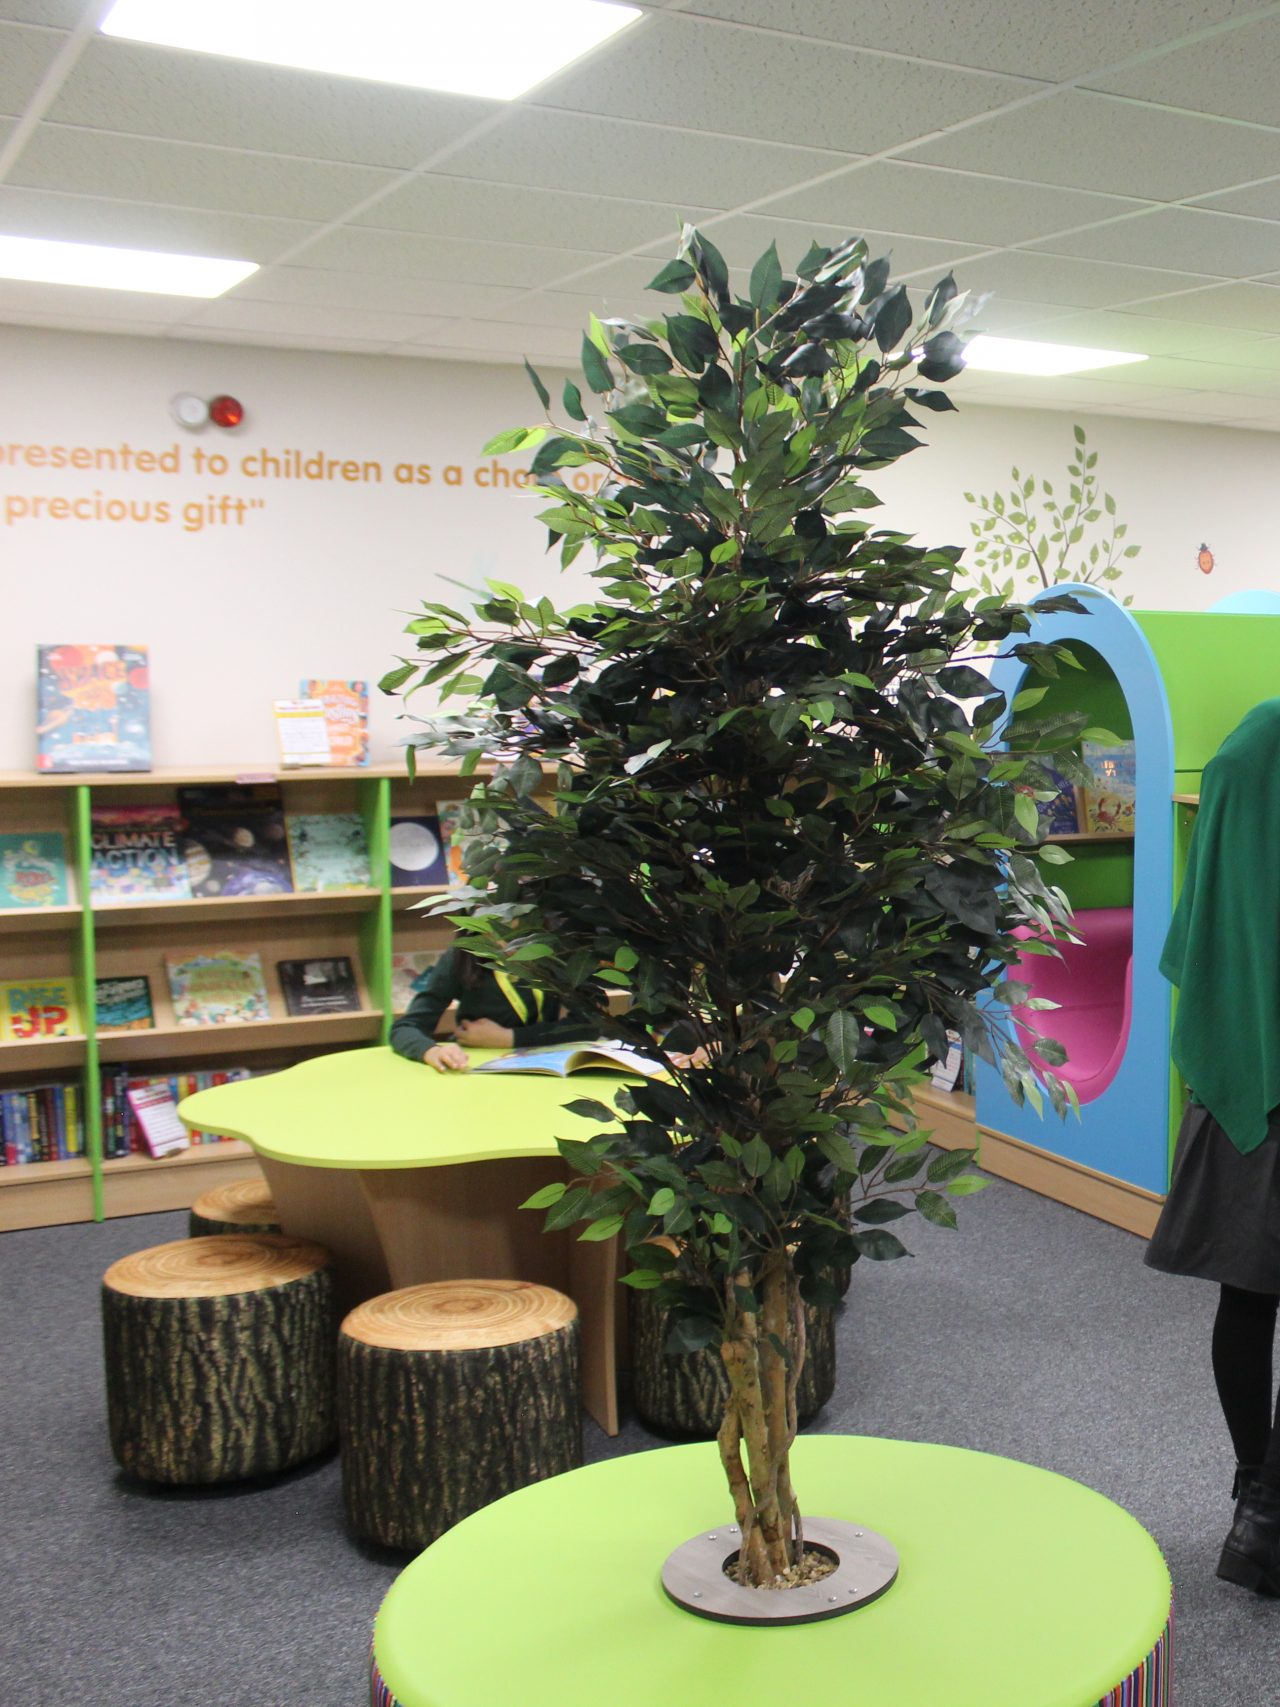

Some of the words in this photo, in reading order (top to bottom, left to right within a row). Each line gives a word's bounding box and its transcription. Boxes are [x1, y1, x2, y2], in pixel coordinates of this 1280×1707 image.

[0, 443, 181, 473] resented
[192, 446, 229, 476] to
[241, 448, 383, 482] children
[394, 463, 431, 485] as
[442, 465, 463, 486] a
[474, 460, 562, 488] cho
[572, 471, 602, 492] or
[5, 489, 171, 526] precious
[182, 494, 265, 532] gift"
[91, 831, 176, 848] CLIMATE
[11, 1006, 68, 1038] UP
